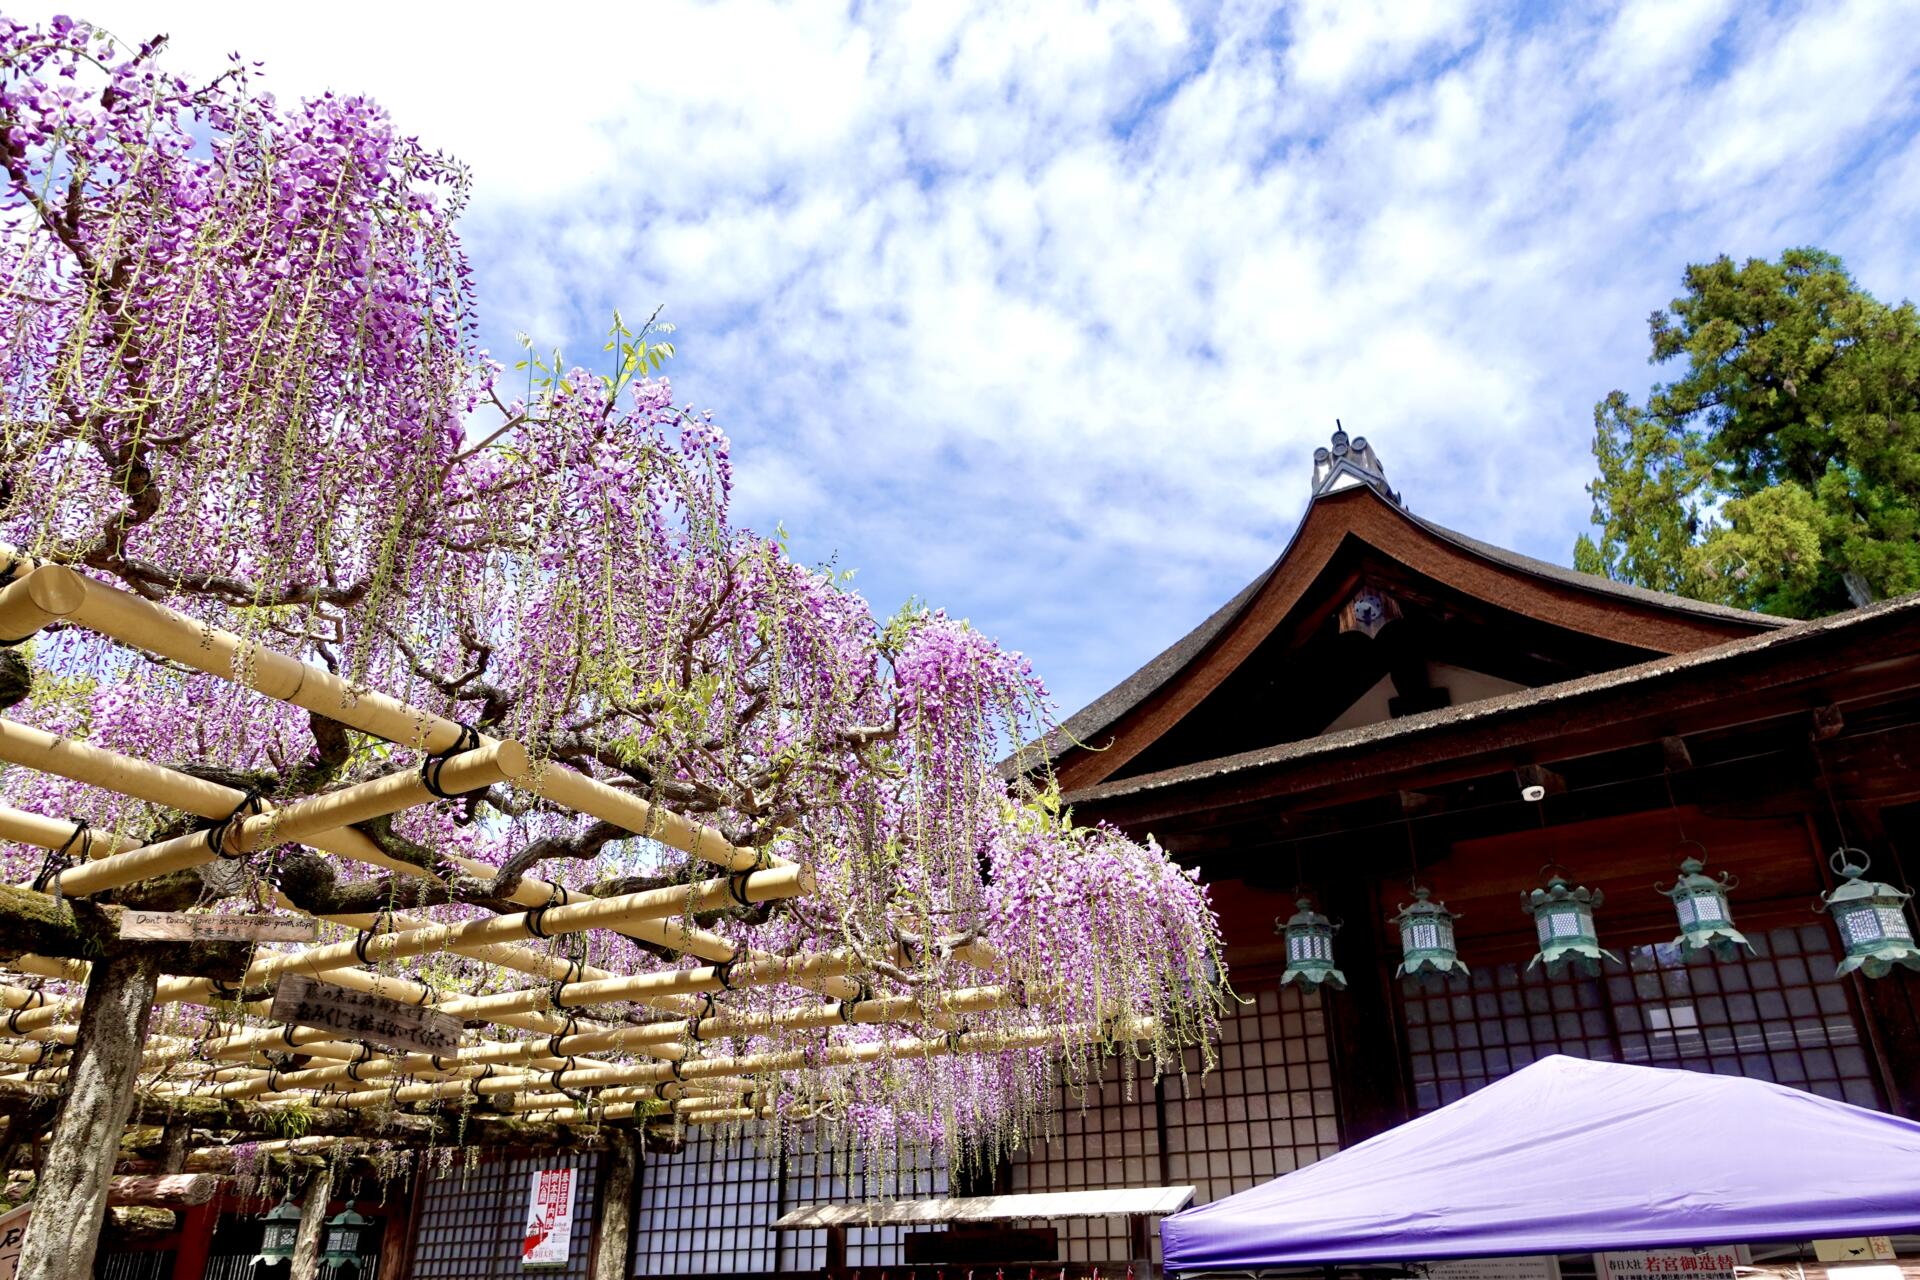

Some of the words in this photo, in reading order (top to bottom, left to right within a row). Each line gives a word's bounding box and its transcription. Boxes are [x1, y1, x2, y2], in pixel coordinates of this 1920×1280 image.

[219, 918, 248, 926] because
[1609, 1258, 1642, 1270] 春日大社
[1645, 1254, 1734, 1272] 若宮御造替
